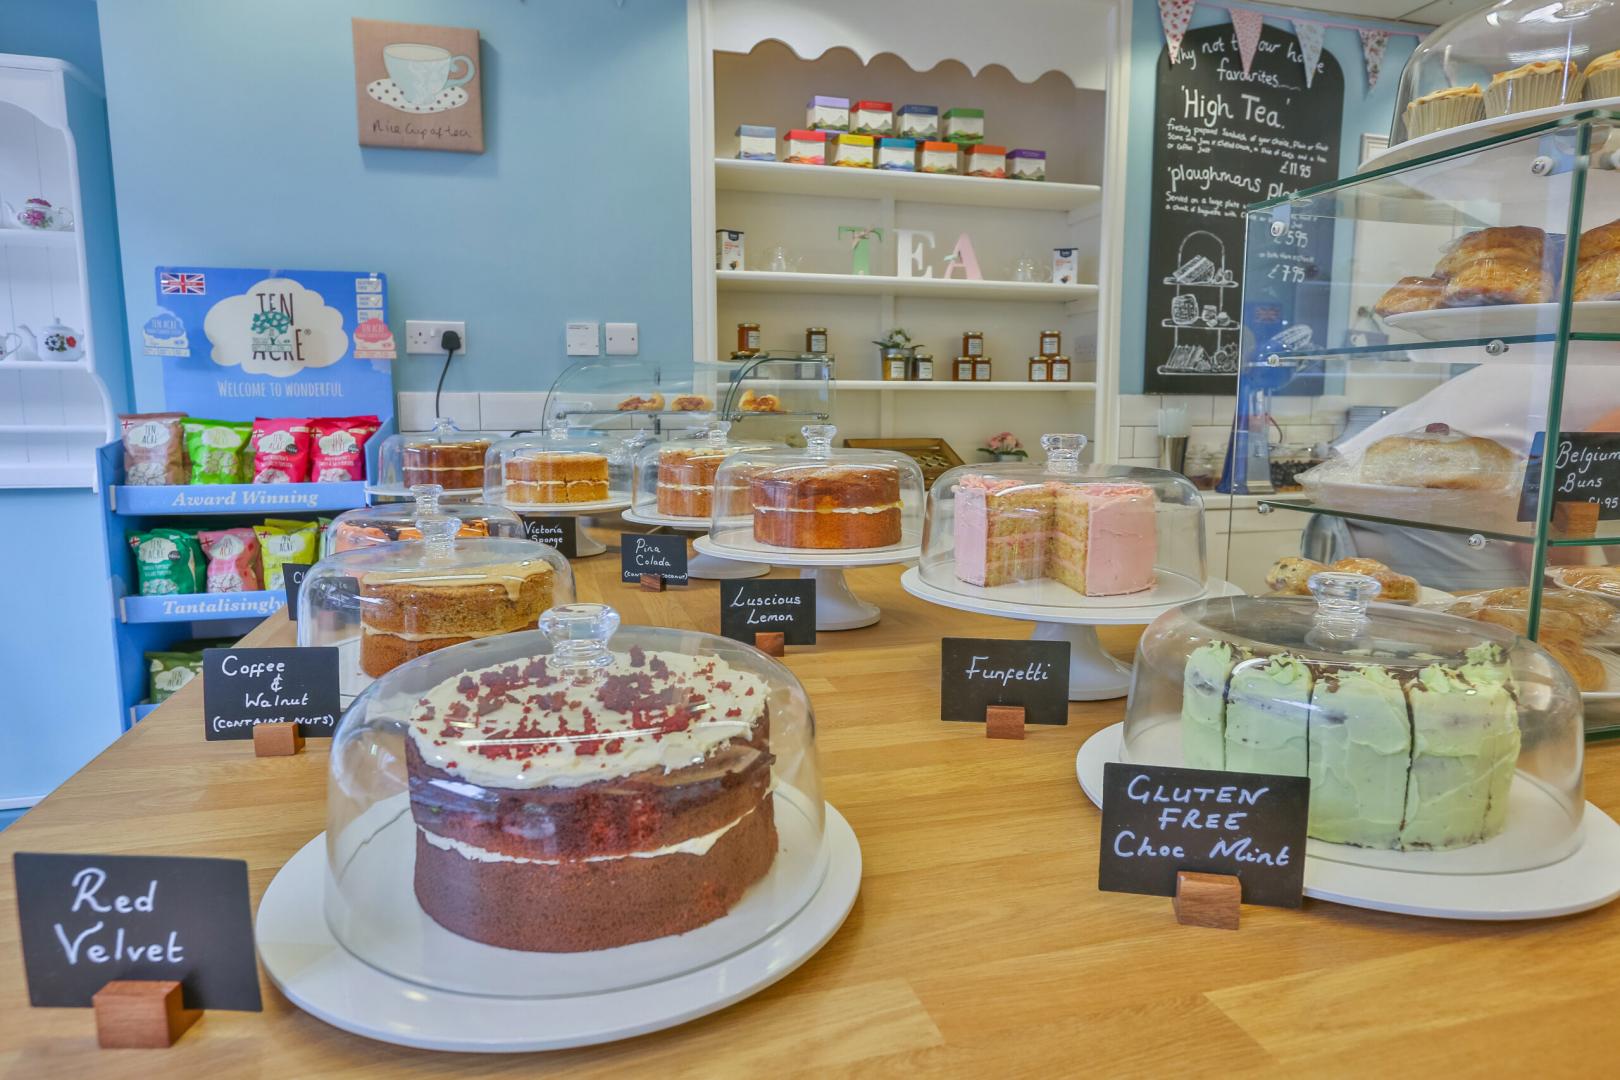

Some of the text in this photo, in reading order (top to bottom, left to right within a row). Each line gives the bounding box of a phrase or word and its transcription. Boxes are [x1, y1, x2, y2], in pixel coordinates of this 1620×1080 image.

[1202, 36, 1225, 54] not
[1258, 40, 1281, 53] our
[217, 380, 344, 398] WELCOME TO WONDERFUL
[1555, 441, 1620, 474] Belgium
[1557, 472, 1603, 493] Buns
[171, 490, 319, 507] Award Winning
[523, 520, 564, 535] Victoria
[635, 538, 661, 553] Pina
[635, 554, 672, 567] Colada
[729, 586, 801, 607] Luscious
[746, 608, 794, 624] Lemon
[222, 655, 286, 677] Coffee
[965, 655, 1052, 687] Funfetti
[245, 692, 309, 708] Walnut
[1127, 774, 1270, 806] GLUTEN
[1158, 807, 1248, 831] FREE
[1113, 830, 1290, 866] Choc Mint
[71, 867, 158, 914] Red
[53, 920, 185, 966] Velvet
